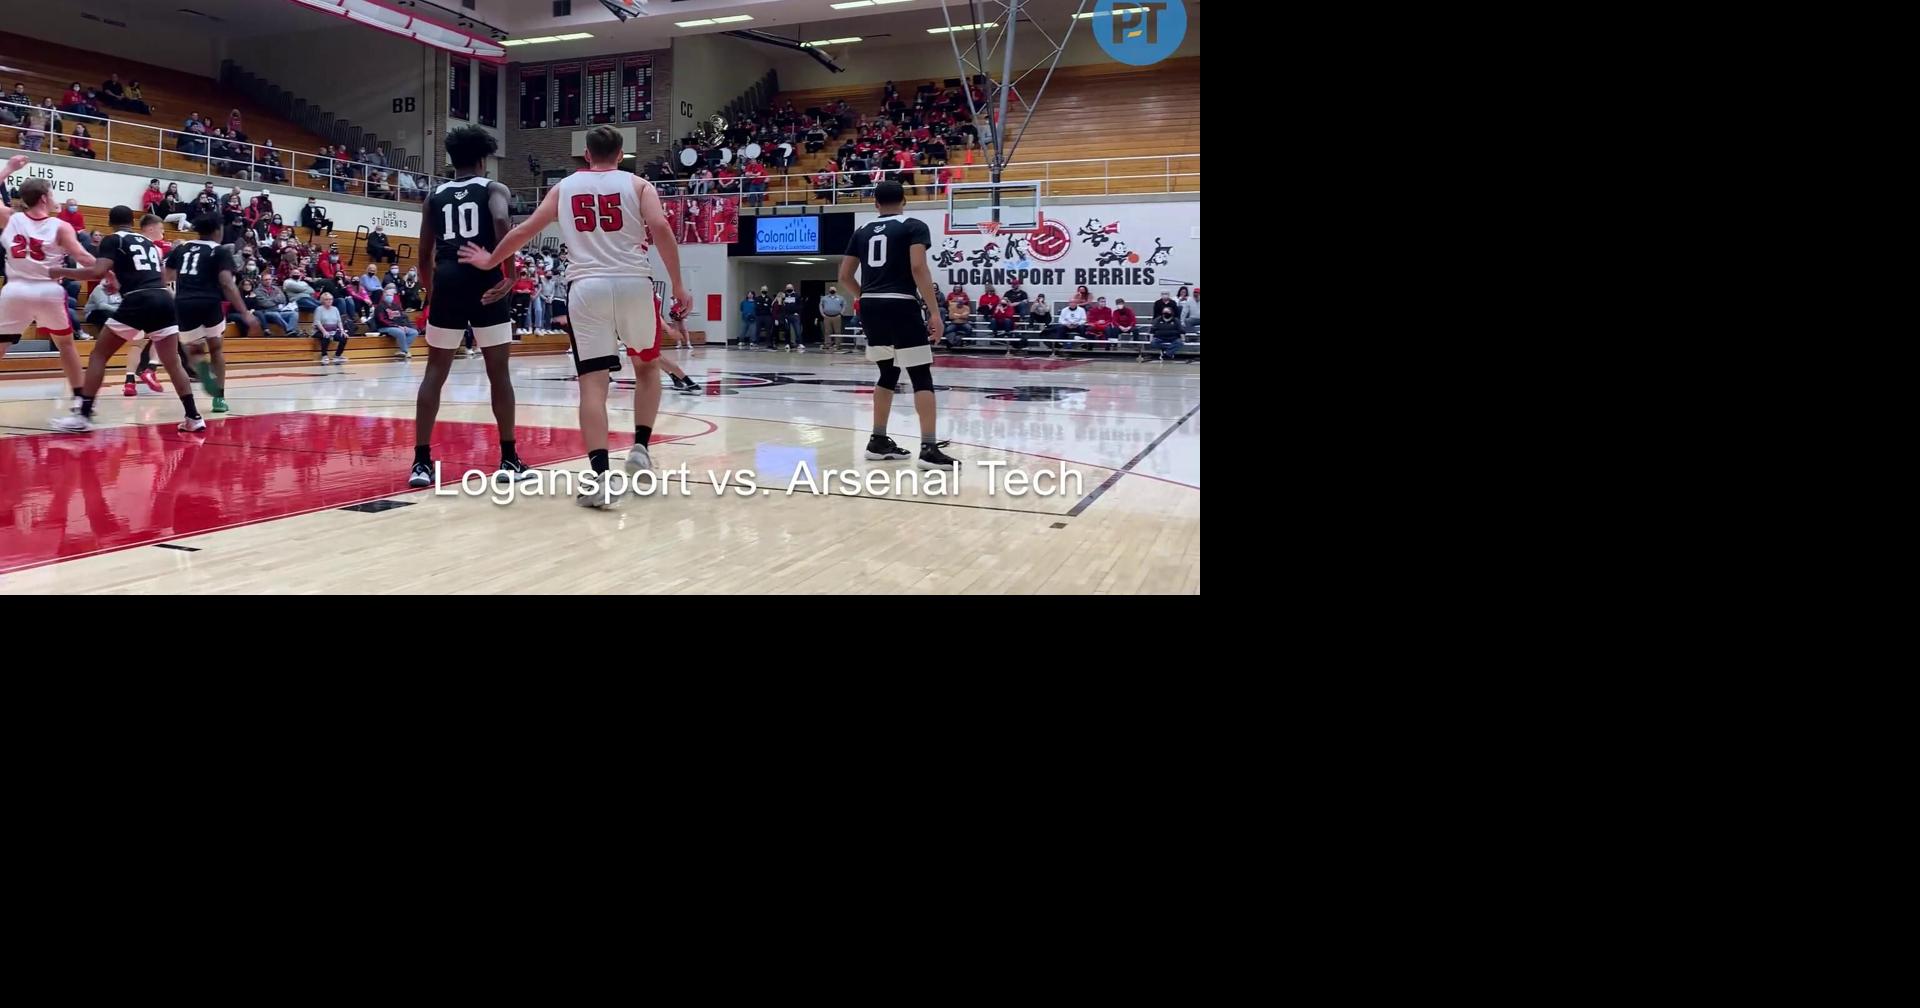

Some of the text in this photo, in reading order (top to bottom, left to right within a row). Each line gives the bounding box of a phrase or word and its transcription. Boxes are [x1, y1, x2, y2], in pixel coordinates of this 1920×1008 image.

[392, 96, 416, 114] BB
[680, 100, 693, 118] CC
[29, 166, 54, 179] LHS
[7, 175, 74, 192] REVED
[441, 201, 480, 241] 10
[571, 192, 624, 233] 55
[371, 216, 408, 229] STUDENTS
[757, 228, 817, 243] Colonial Life
[129, 243, 161, 273] 24
[867, 234, 888, 267] 0
[180, 251, 201, 275] 11
[948, 267, 1156, 286] LOGANSPORT BERRIES
